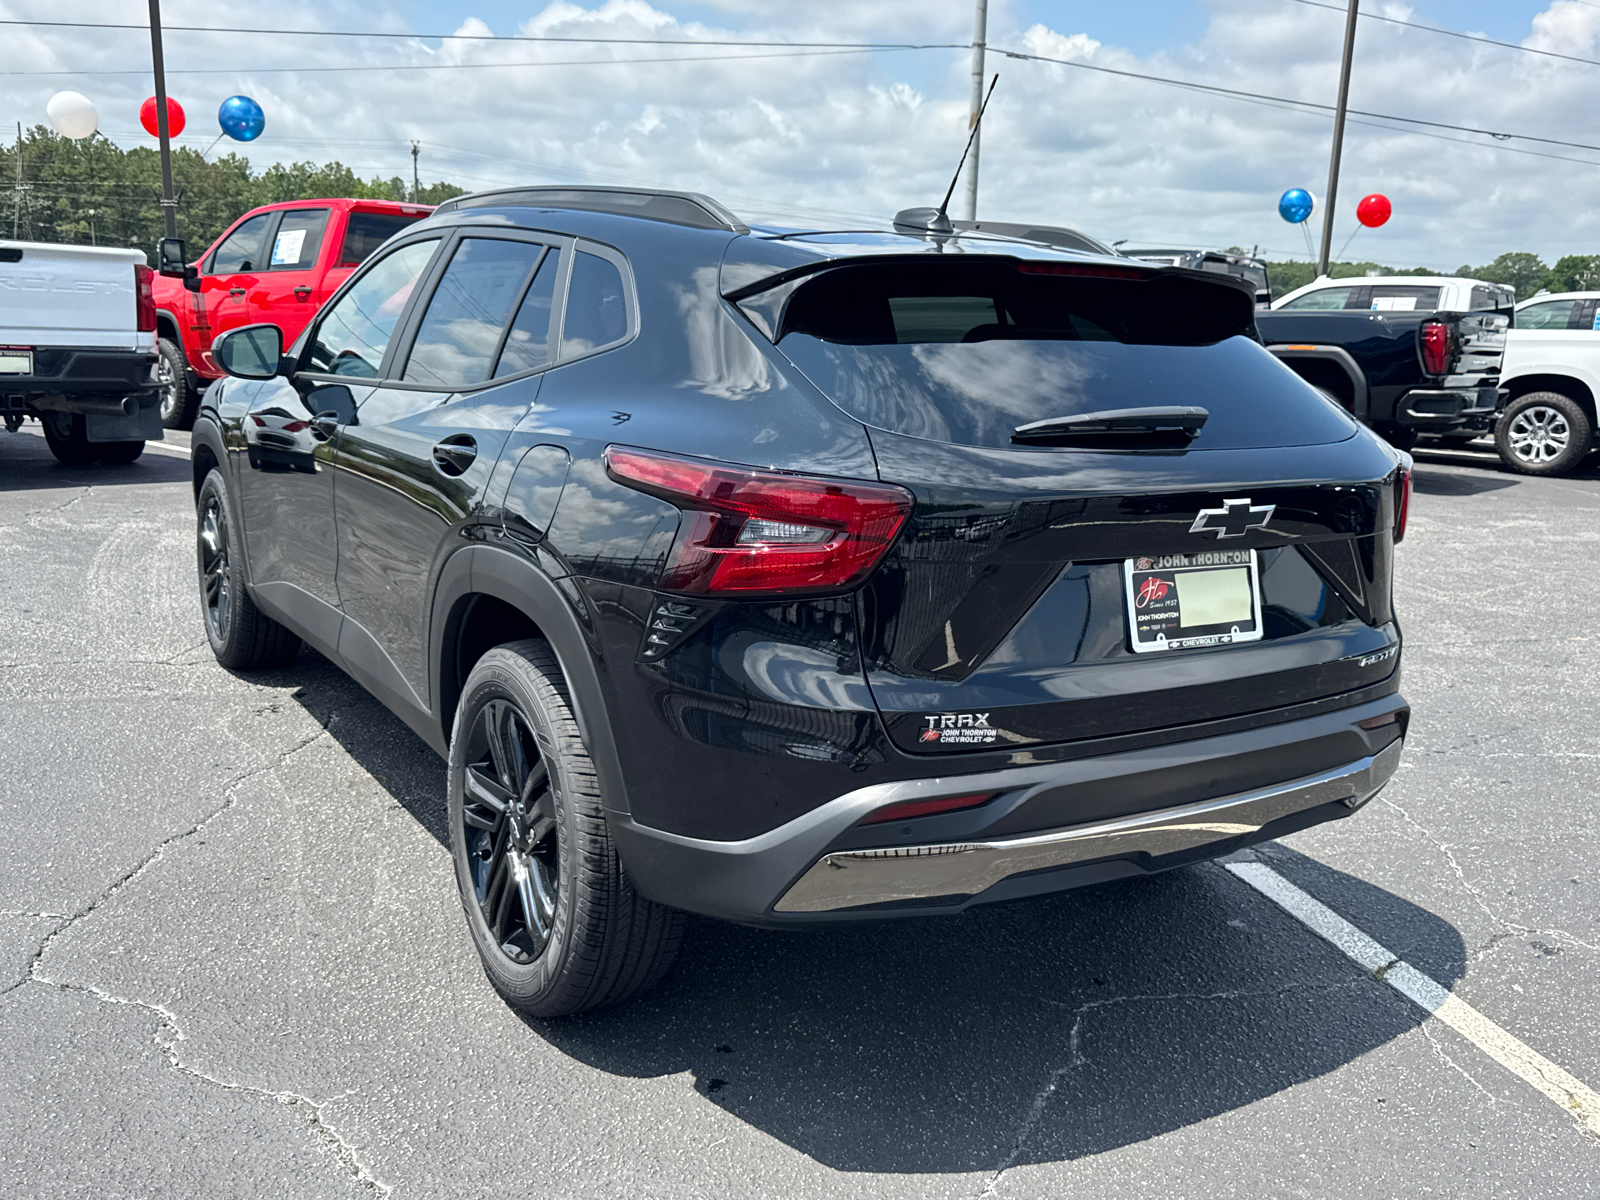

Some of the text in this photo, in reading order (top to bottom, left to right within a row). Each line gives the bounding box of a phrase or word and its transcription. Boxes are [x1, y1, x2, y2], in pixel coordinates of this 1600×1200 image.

[1157, 554, 1189, 568] JOHN
[1137, 611, 1179, 622] JOHN THORNTON
[1182, 637, 1219, 647] CHEVROLET
[924, 712, 990, 730] TRAX
[941, 728, 997, 737] JOHN THORNTON
